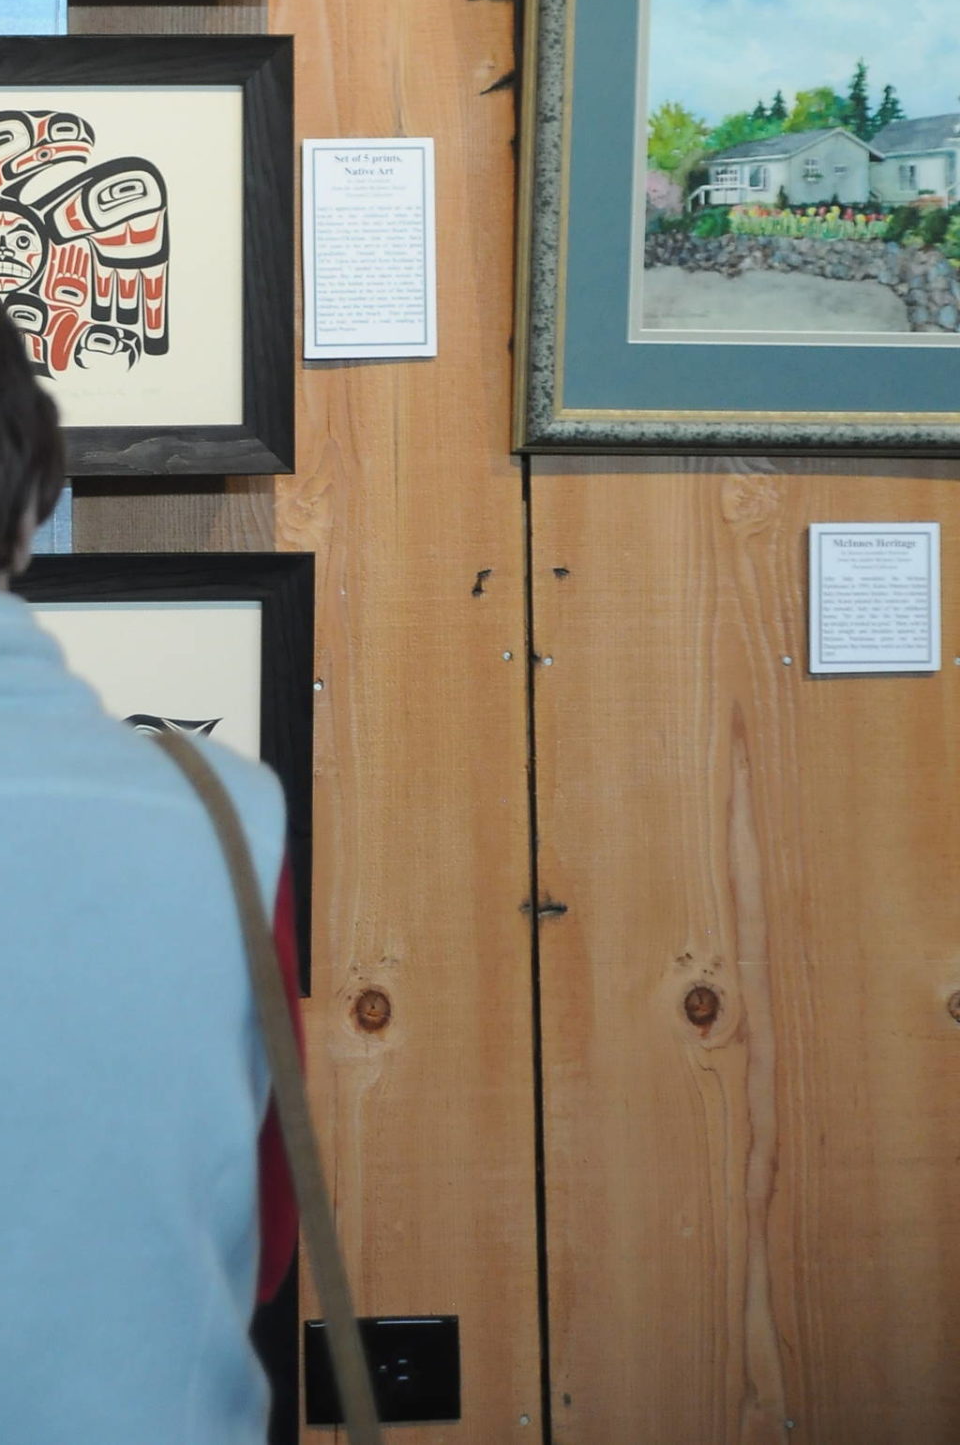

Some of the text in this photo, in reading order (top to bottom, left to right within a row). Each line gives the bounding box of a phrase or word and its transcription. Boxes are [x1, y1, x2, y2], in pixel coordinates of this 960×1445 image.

[334, 154, 349, 163] Set
[352, 154, 361, 163] of
[344, 167, 394, 176] Native Art
[876, 539, 916, 549] Heritage
